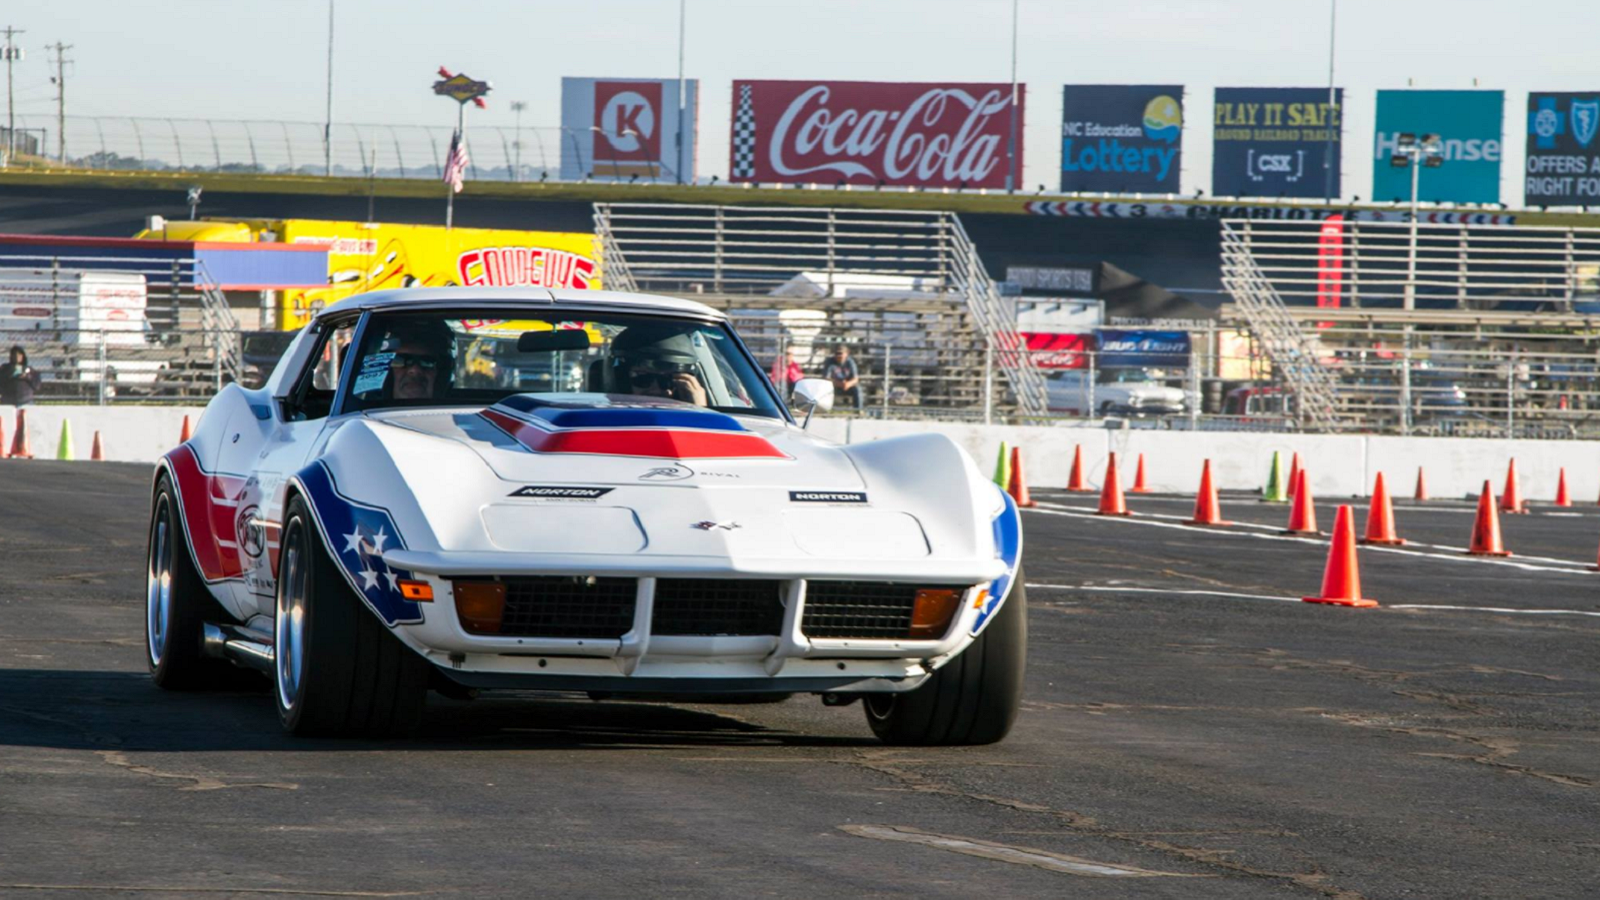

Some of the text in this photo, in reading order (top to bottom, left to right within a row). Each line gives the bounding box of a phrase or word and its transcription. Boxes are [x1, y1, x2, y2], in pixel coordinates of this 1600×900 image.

[1215, 103, 1340, 126] PLAY IT SAFE
[769, 85, 1012, 181] Coca-Cola
[1063, 122, 1142, 137] NC Education
[1375, 132, 1501, 161] Hnse
[1063, 138, 1176, 182] Lottery
[1258, 155, 1292, 171] CSX
[1528, 155, 1587, 173] OFFERS
[1526, 176, 1600, 196] RIGHT FO
[1130, 203, 1148, 217] 3
[1186, 204, 1359, 222] CHARLOTE
[521, 487, 600, 496] NORTON
